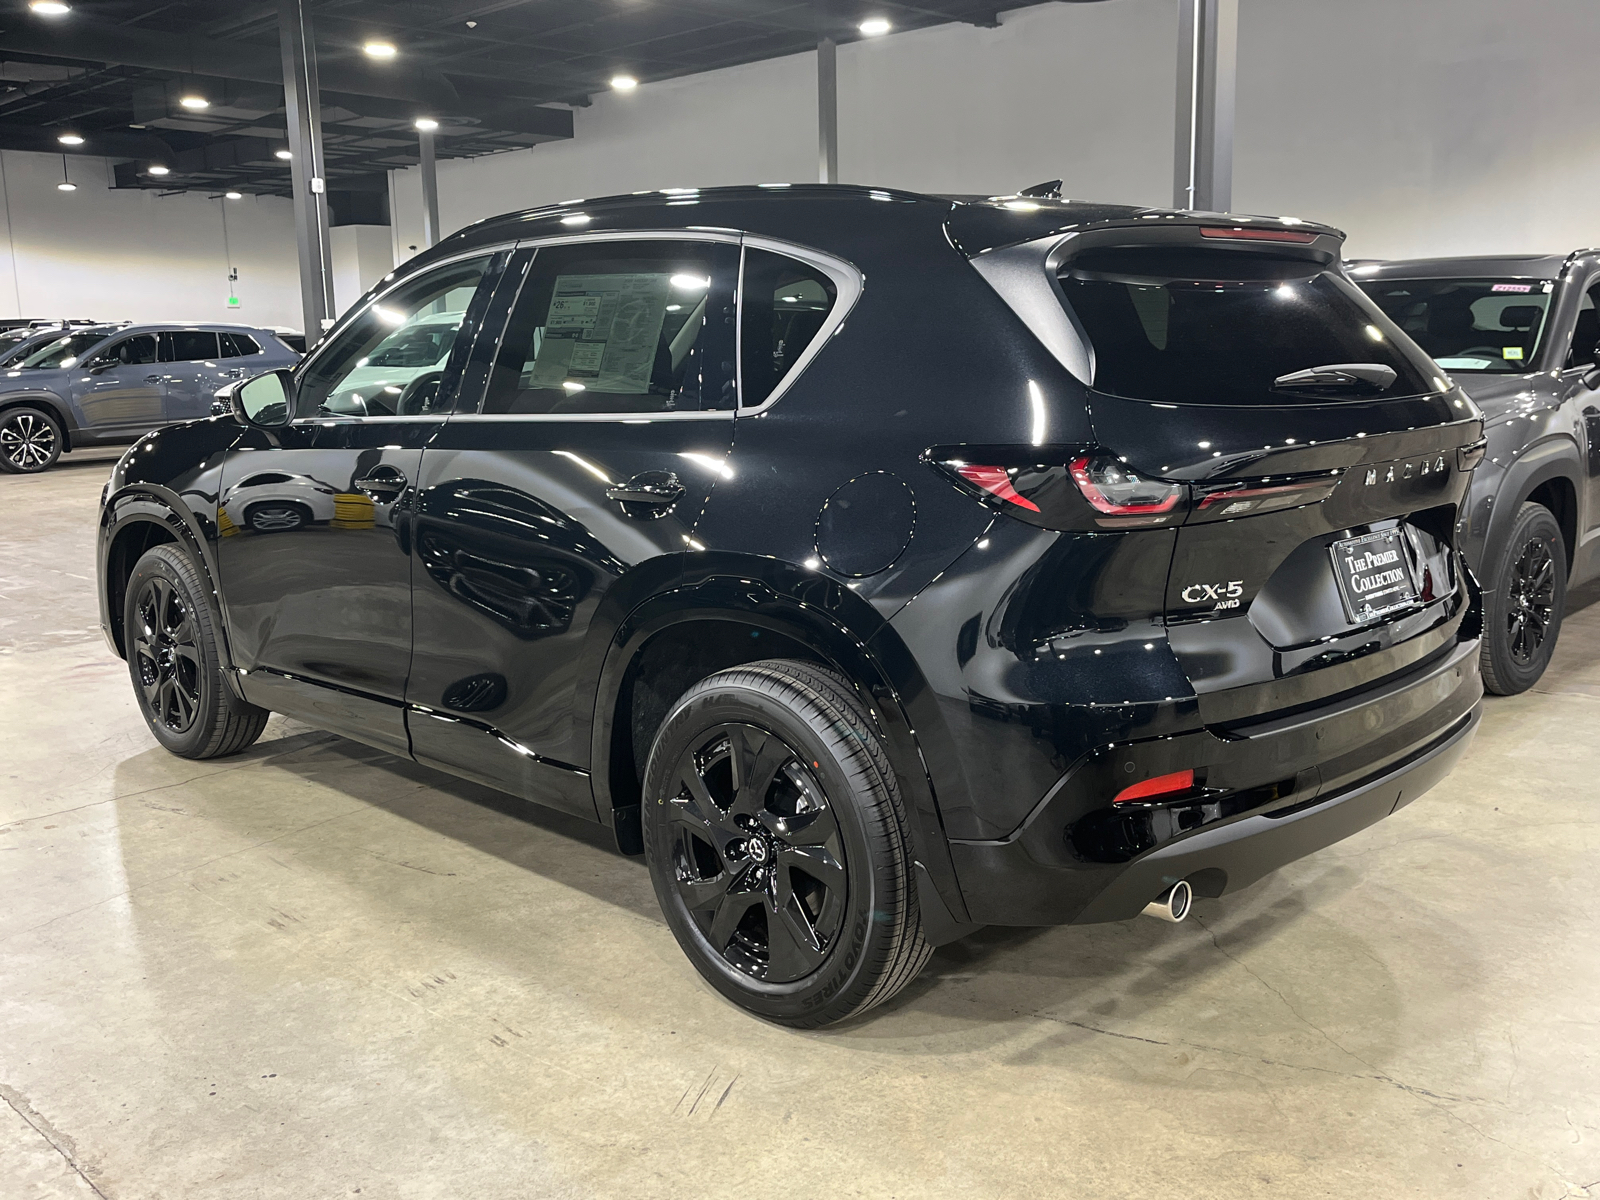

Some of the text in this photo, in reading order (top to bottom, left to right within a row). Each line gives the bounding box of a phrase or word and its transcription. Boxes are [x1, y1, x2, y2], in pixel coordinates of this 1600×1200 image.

[555, 300, 565, 309] 26
[1365, 456, 1444, 486] MAZDA
[1345, 549, 1399, 574] THE PREMIER
[1181, 580, 1243, 603] CX-5
[1351, 567, 1404, 593] COLLECTION
[1214, 599, 1240, 610] AWD
[842, 908, 868, 972] TOYO
[801, 968, 848, 1011] TIRES
